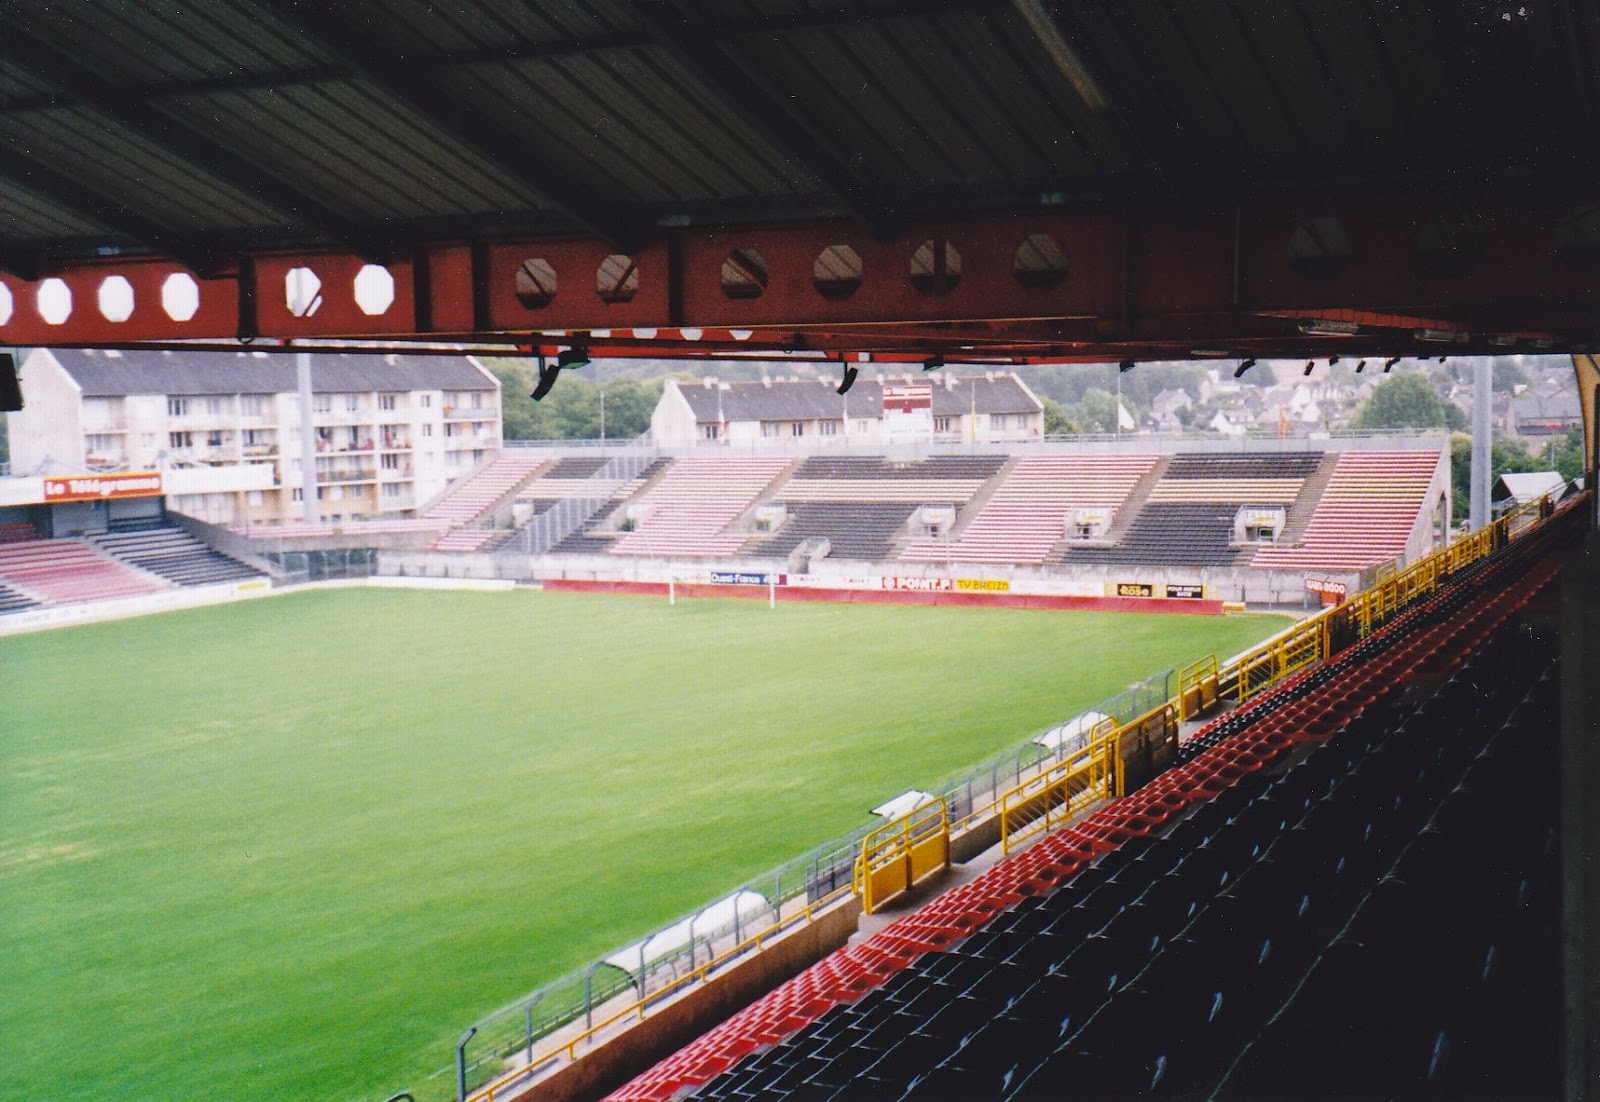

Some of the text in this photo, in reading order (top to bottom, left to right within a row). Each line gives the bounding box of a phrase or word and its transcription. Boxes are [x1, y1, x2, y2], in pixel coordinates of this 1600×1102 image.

[46, 477, 160, 496] Le Télégramme
[711, 573, 761, 584] Ouest-France
[957, 580, 971, 590] TV
